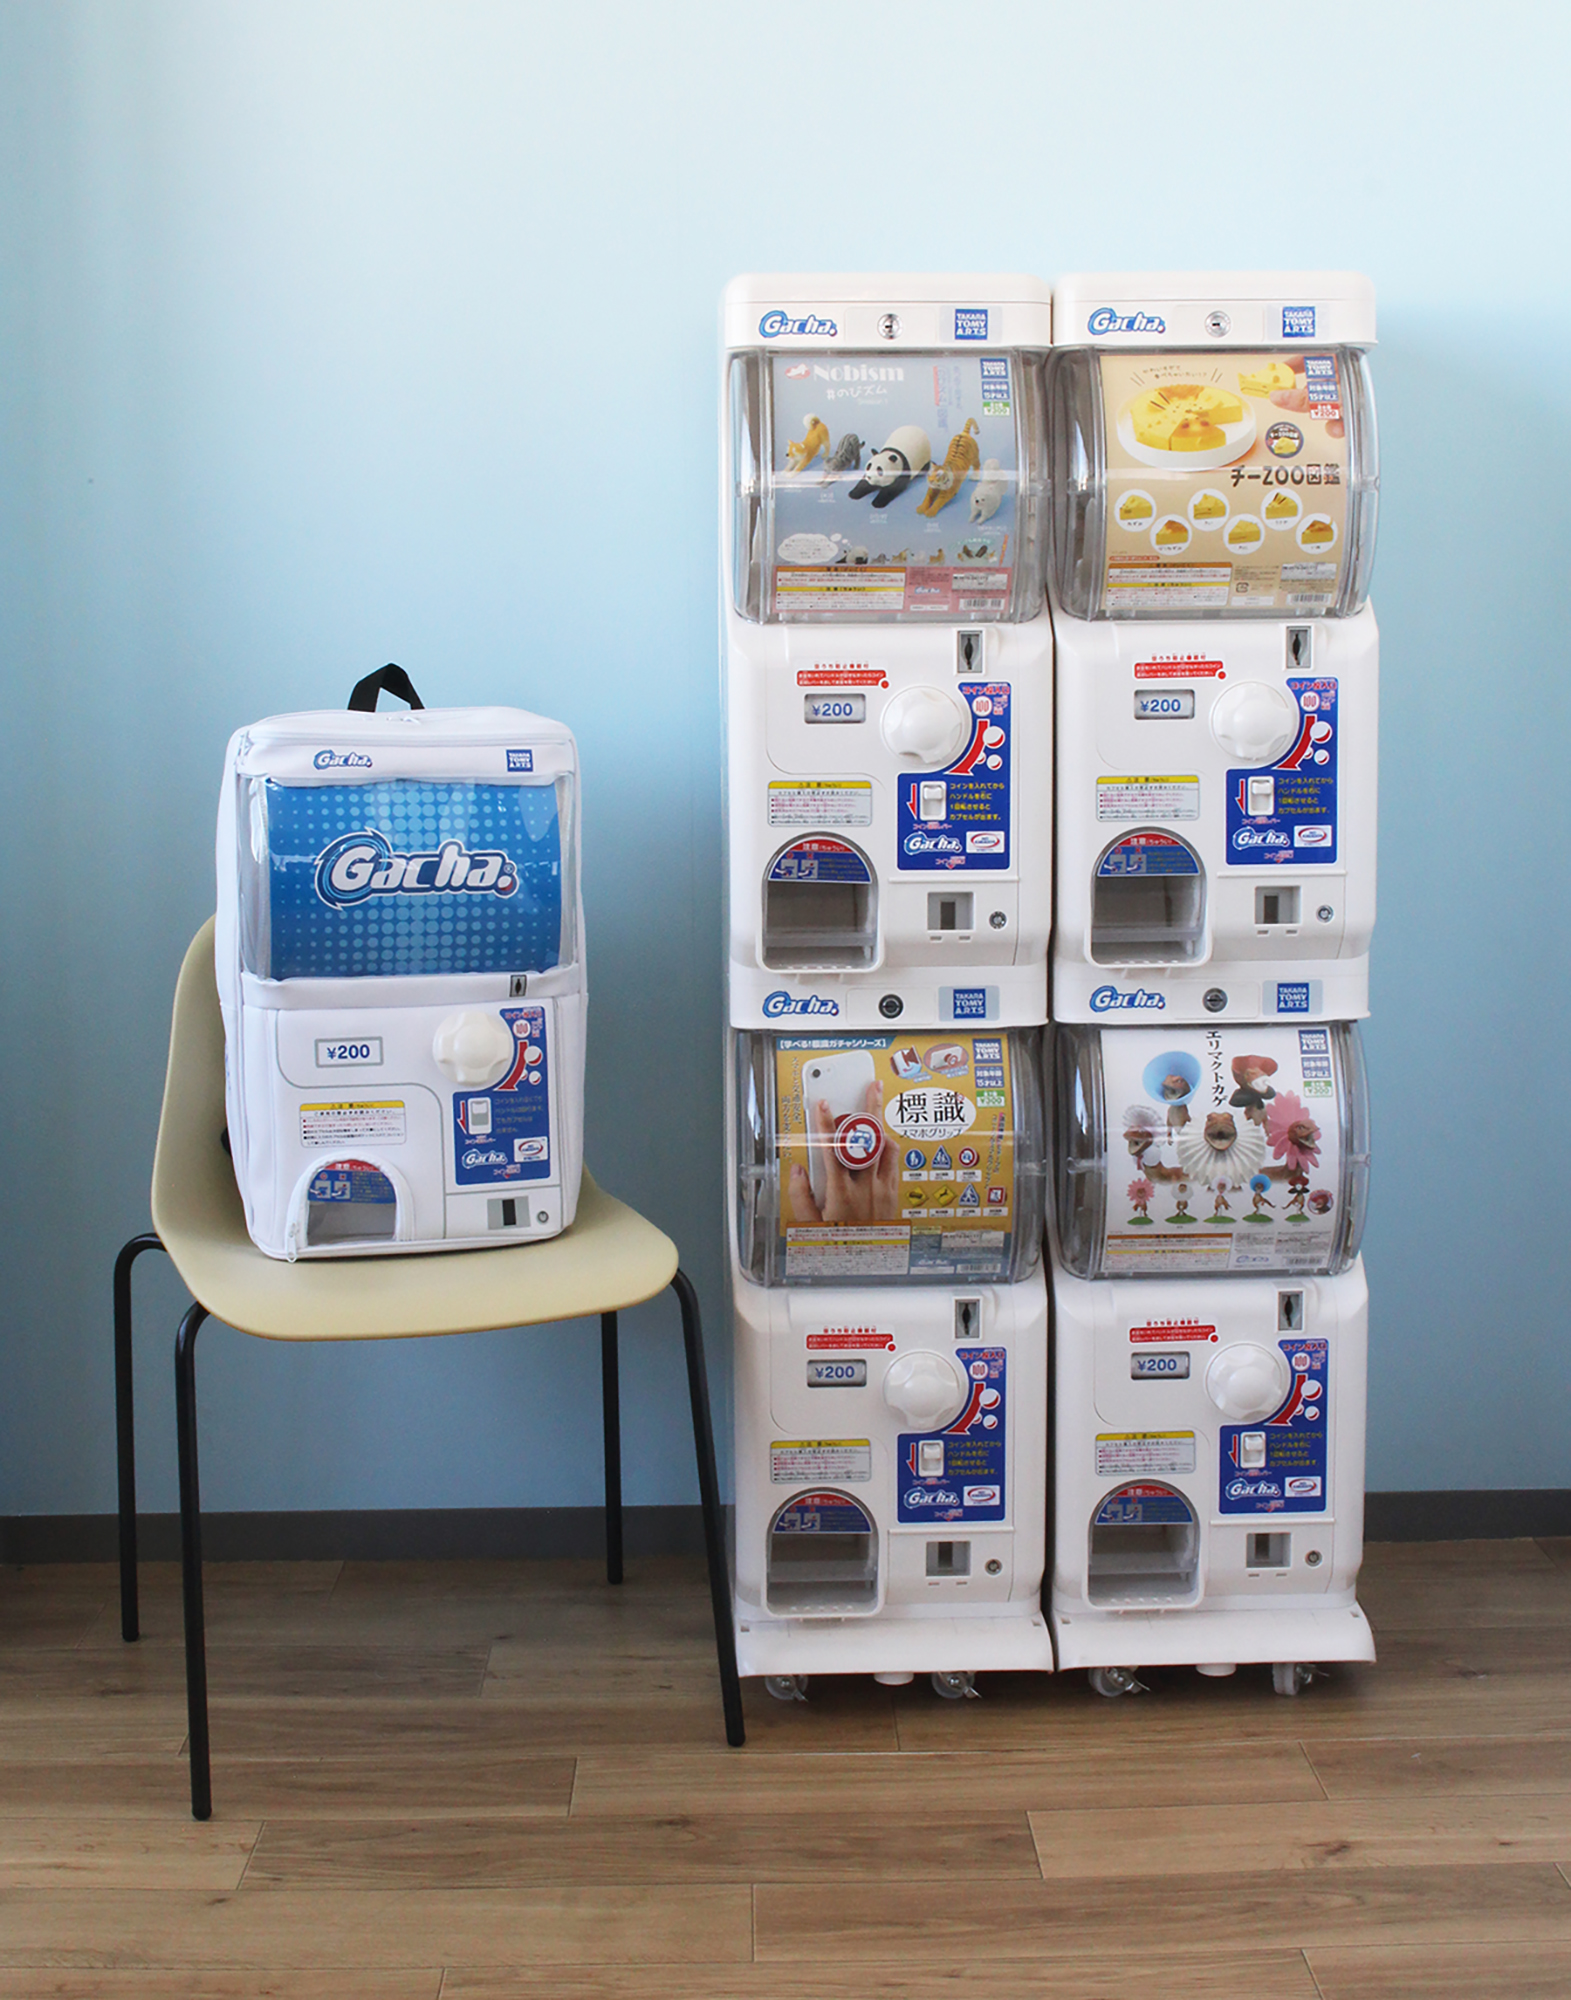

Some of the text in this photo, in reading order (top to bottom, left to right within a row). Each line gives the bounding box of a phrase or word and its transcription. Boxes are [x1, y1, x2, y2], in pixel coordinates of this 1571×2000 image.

[956, 320, 986, 328] TOMY
[1284, 325, 1314, 333] ARTS
[956, 328, 986, 336] ARTS
[812, 364, 905, 382] Nobism
[812, 702, 853, 716] ¥200
[1140, 698, 1182, 713] ¥200
[326, 1044, 370, 1059] ¥200
[1206, 1030, 1228, 1107] エリマクトカゲ
[895, 1091, 966, 1124] 標識
[900, 1127, 963, 1139] スマホグリップ
[1137, 1358, 1177, 1371] ¥200
[815, 1365, 855, 1379] ¥200
